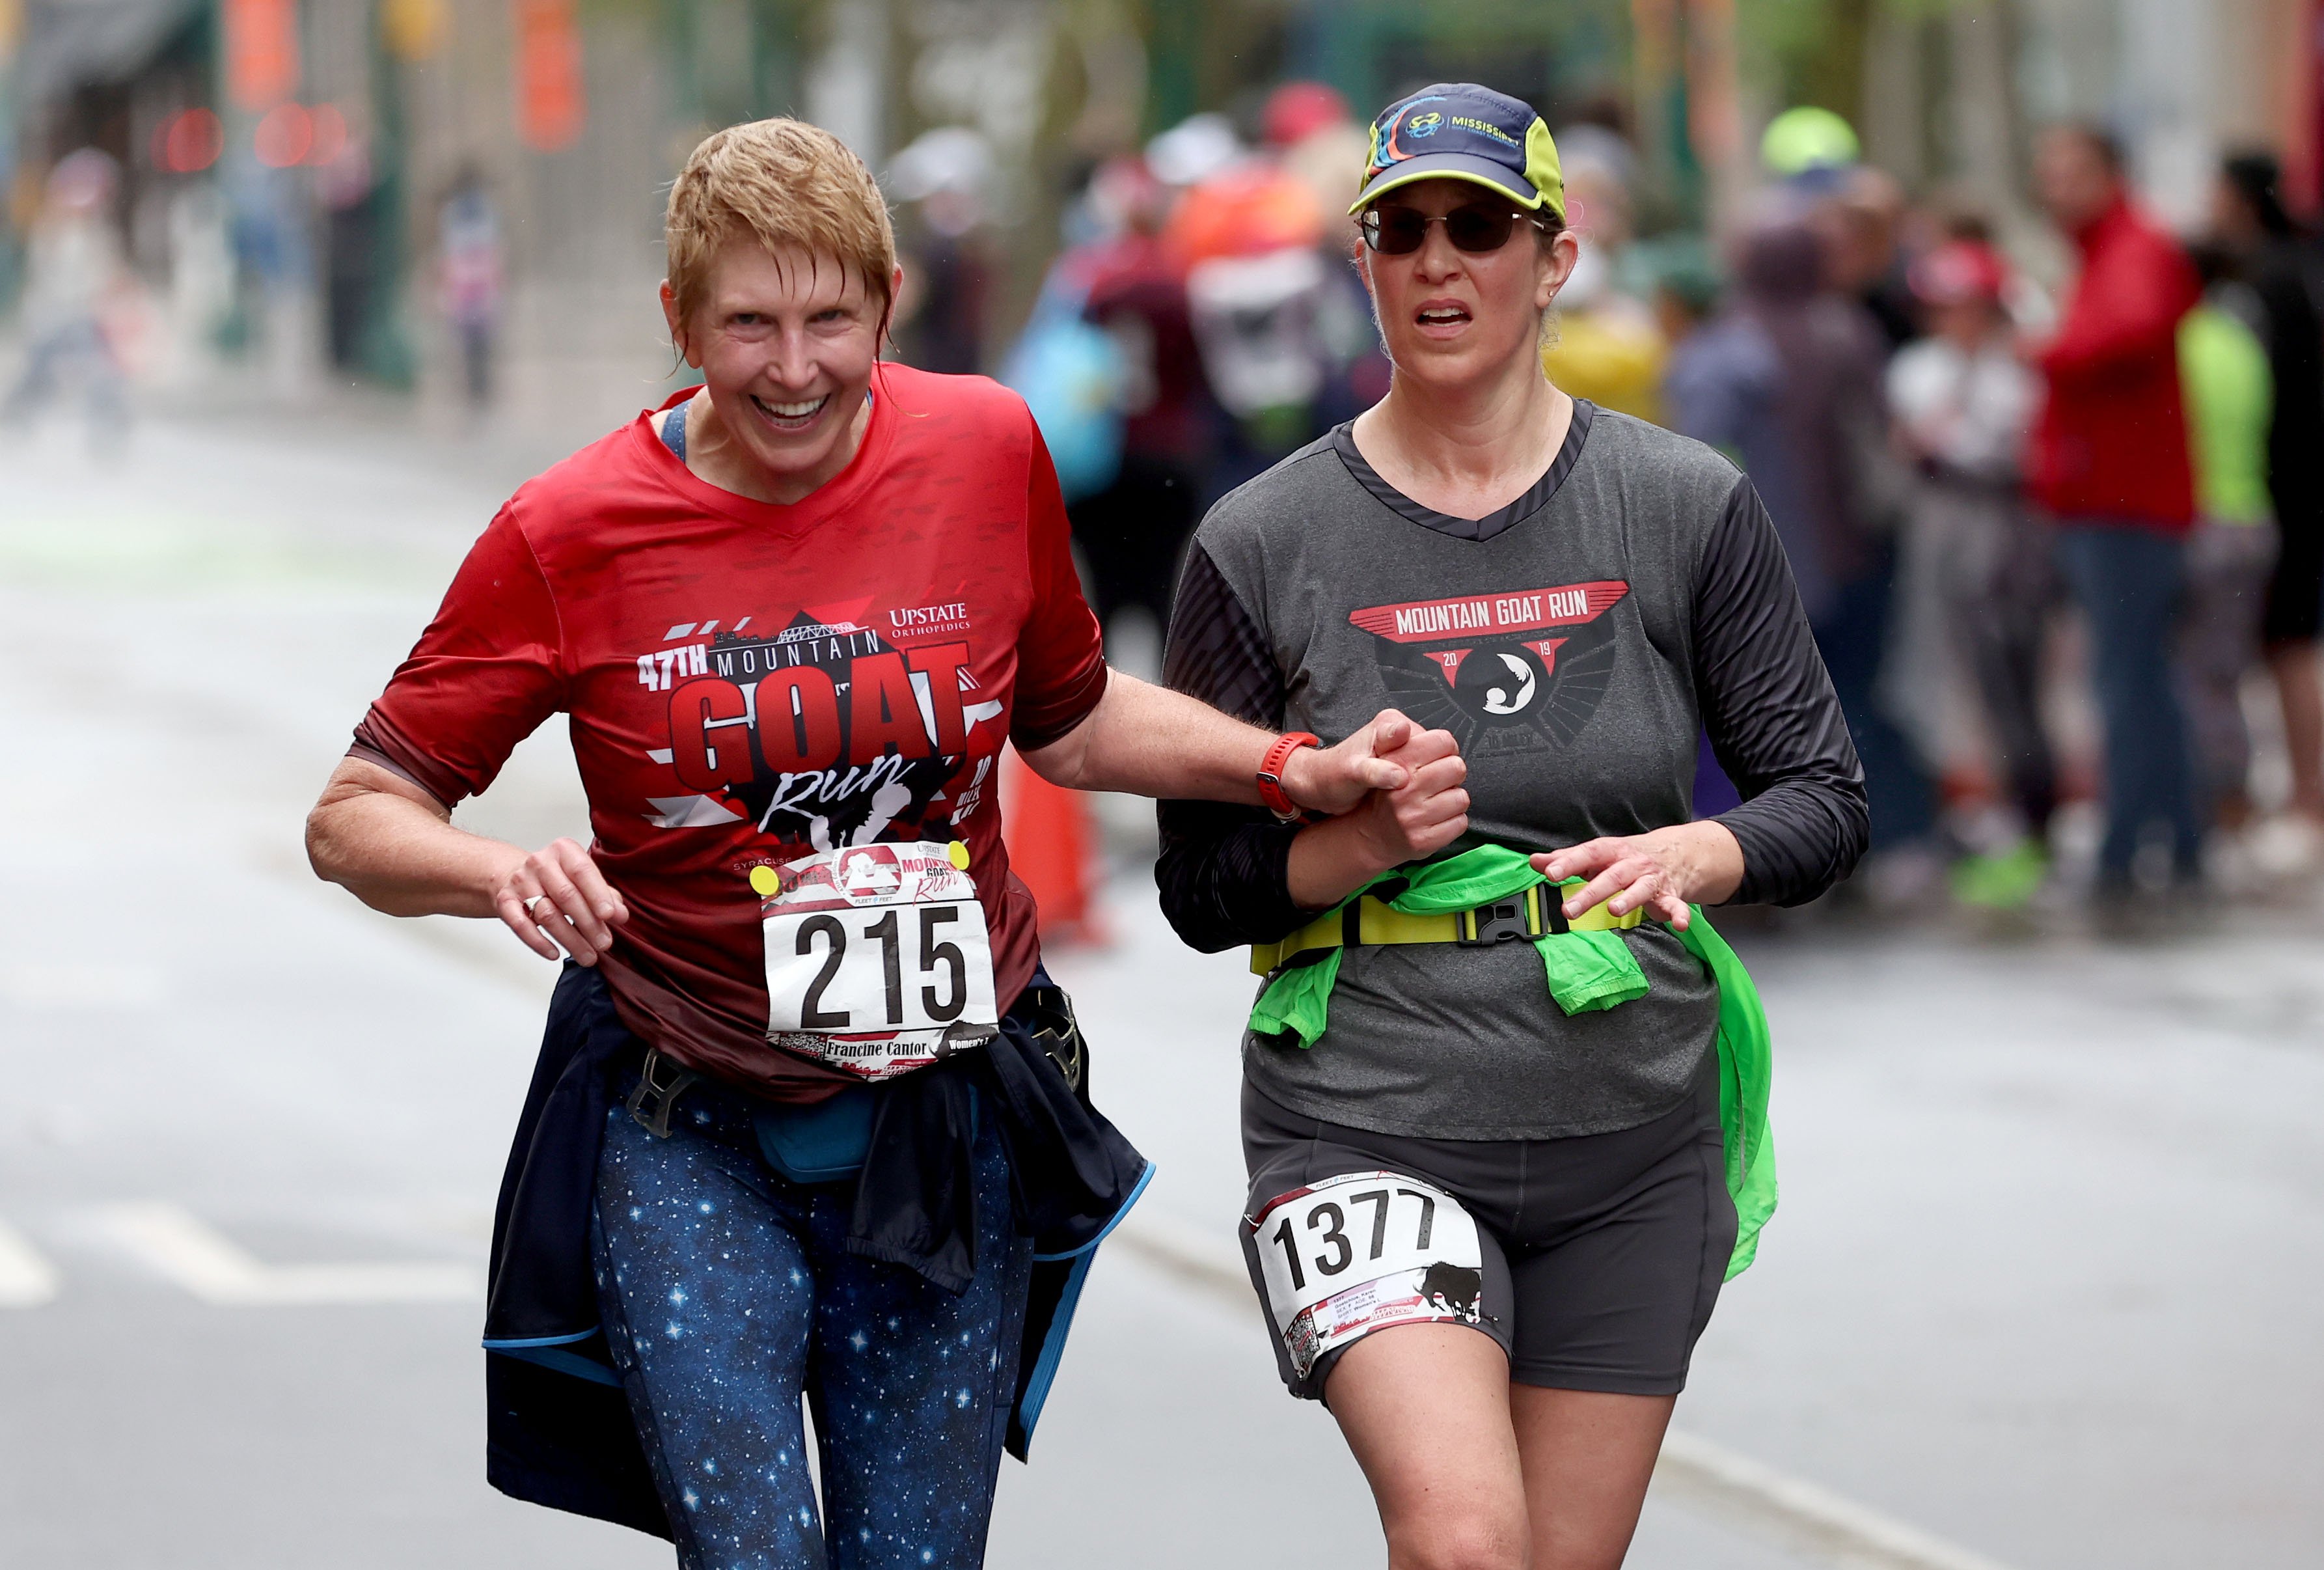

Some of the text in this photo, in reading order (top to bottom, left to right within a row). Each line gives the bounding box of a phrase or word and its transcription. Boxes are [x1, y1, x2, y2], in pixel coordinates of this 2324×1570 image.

[889, 602, 966, 627] UPSTATE
[1395, 589, 1589, 635] MOUNTAIN GOAT RUN
[892, 621, 970, 638] ORTHOPEDICS
[636, 629, 880, 692] 47TH MOUNTAIN
[1442, 641, 1552, 667] 20 19
[668, 640, 970, 792] GOAT
[969, 754, 992, 788] 10
[733, 857, 792, 871] SYRACUSE
[795, 905, 966, 1029] 215
[826, 1041, 927, 1057] Francine Cantor
[948, 1038, 983, 1050] Women's
[1316, 1179, 1333, 1188] FLEET
[1273, 1189, 1435, 1292] 1377
[1354, 1300, 1376, 1311] Women's
